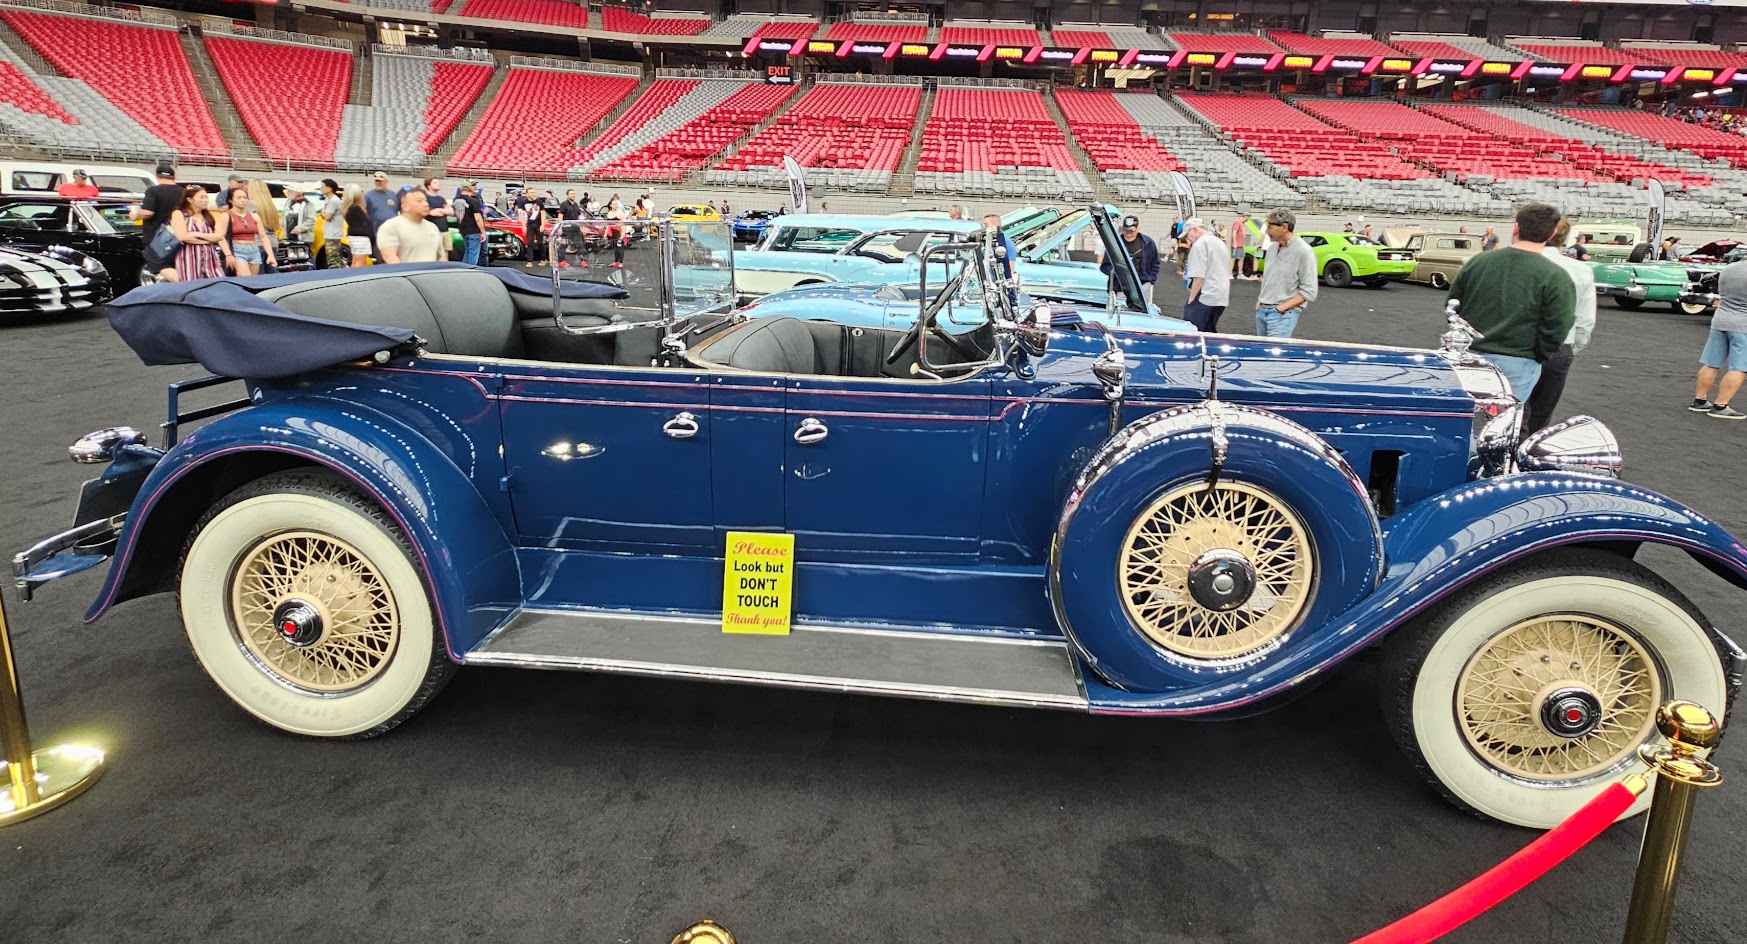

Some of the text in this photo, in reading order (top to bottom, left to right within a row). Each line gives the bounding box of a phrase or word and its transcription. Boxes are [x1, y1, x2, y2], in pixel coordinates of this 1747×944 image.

[768, 66, 790, 76] EXIT
[733, 541, 787, 556] Please
[734, 560, 784, 573] Look but
[740, 577, 777, 590] DON'T
[737, 594, 778, 607] TOUCH
[726, 613, 787, 628] Thank you!
